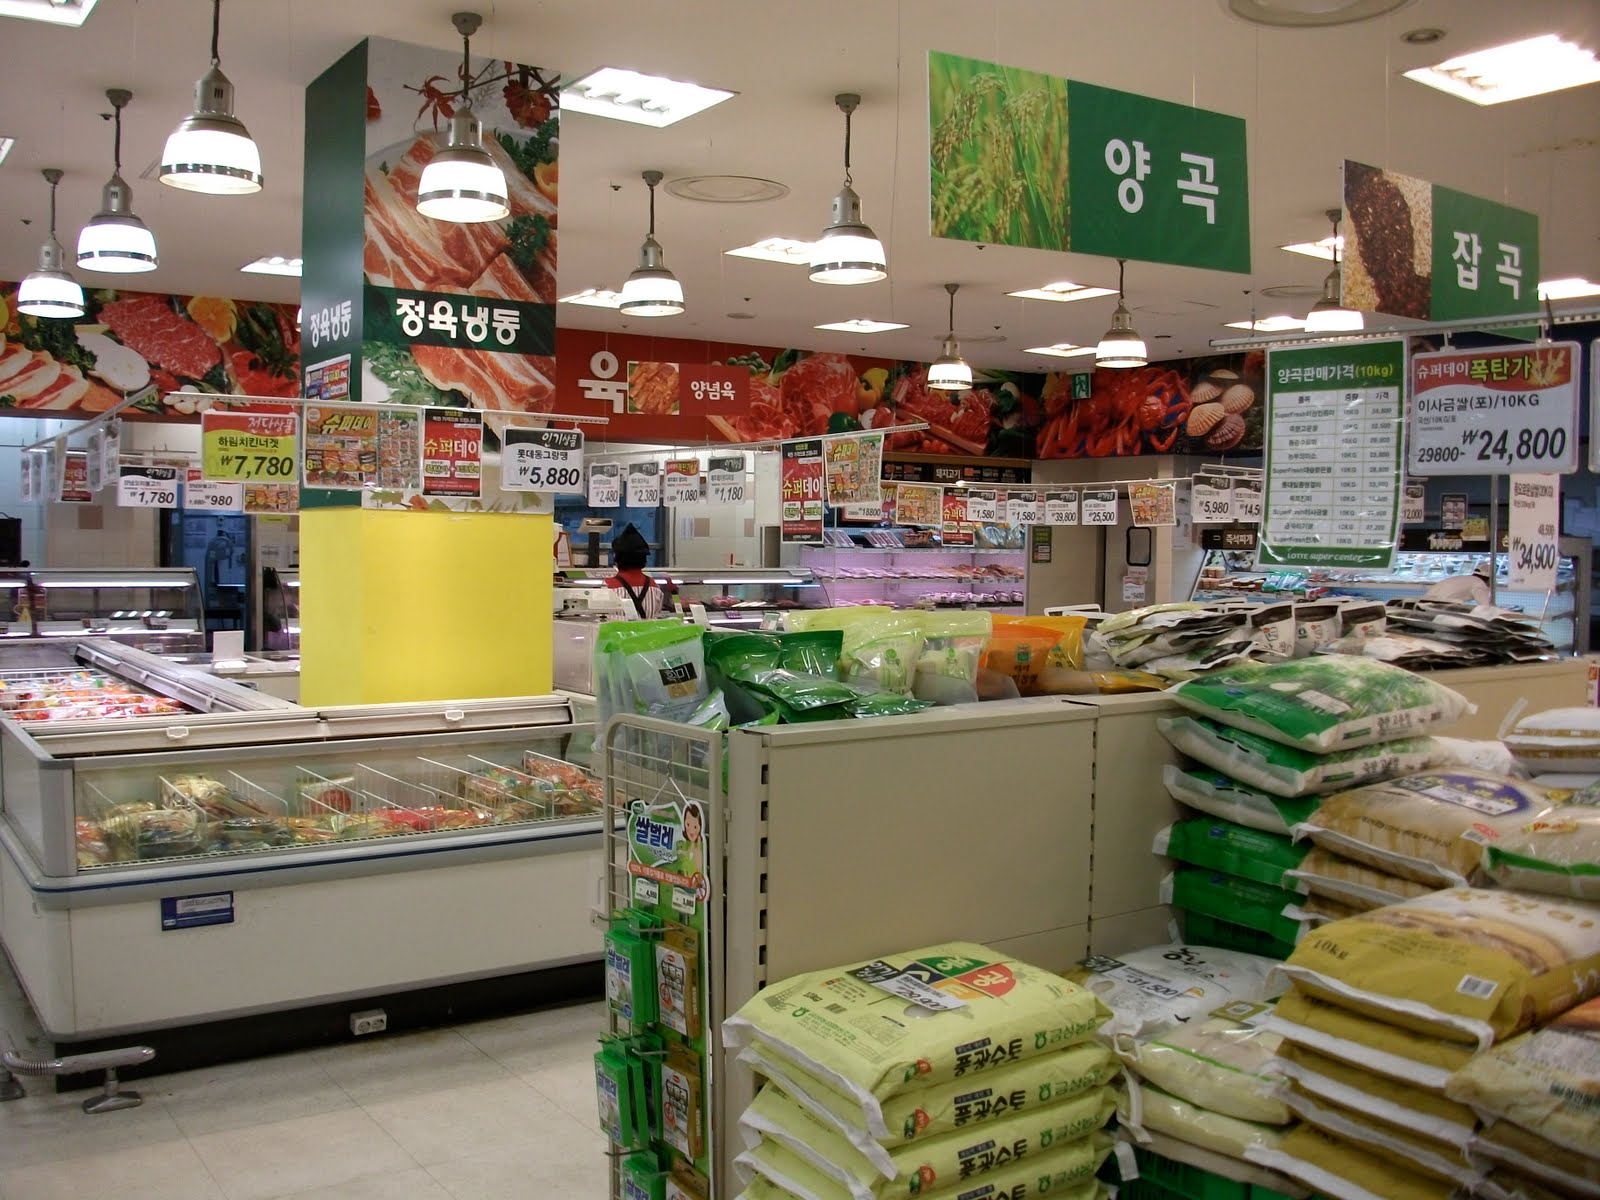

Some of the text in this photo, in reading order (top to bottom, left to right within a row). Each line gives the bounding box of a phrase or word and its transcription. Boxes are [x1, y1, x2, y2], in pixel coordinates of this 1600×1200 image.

[310, 300, 352, 349] 정육냉동
[396, 298, 521, 346] 정육냉동
[1417, 355, 1531, 382] 슈퍼데이 폭탄가
[691, 381, 736, 401] 양념육
[248, 417, 293, 434] 전단상품
[218, 436, 279, 448] 하림치킨너겟
[425, 437, 481, 459] 슈퍼데이
[542, 432, 579, 448] 인기상품
[1462, 427, 1566, 466] ₩24,800
[517, 449, 568, 461] 롯데동그랑땡
[221, 455, 294, 479] ₩7,780
[519, 466, 580, 488] ₩5,880
[936, 468, 961, 479] 돼지고기
[783, 477, 822, 499] 슈퍼데이
[1287, 552, 1308, 560] LOTTE
[1309, 553, 1333, 562] super
[1313, 939, 1349, 962] 10kg
